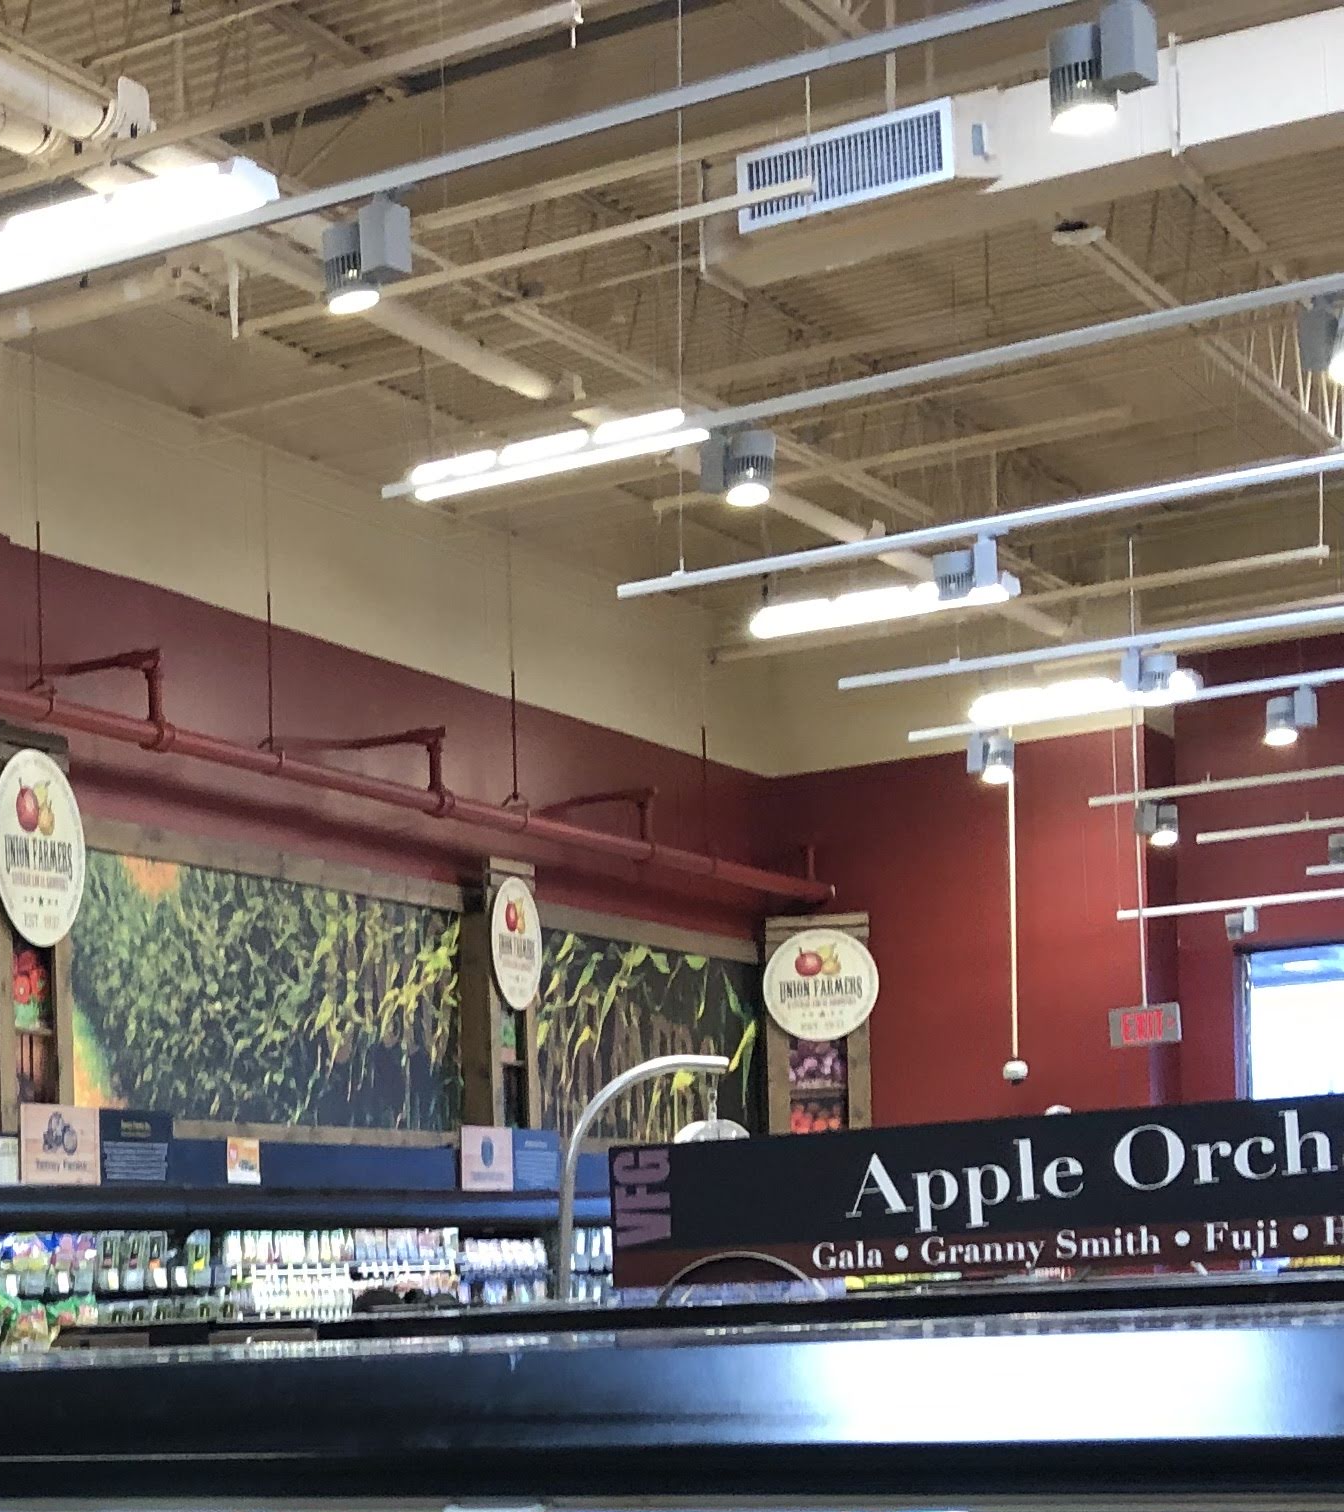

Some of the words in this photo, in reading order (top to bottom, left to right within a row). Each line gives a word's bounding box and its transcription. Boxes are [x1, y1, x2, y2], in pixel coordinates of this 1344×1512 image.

[4, 834, 30, 874] UNION
[32, 837, 73, 880] FARMERS
[779, 980, 810, 1003] UNION
[813, 976, 863, 999] FARMERS
[1121, 1008, 1164, 1042] EXIT
[845, 1137, 1085, 1233] Apple
[1111, 1108, 1344, 1191] Orch
[612, 1146, 671, 1248] VFG
[812, 1241, 884, 1272] Gala
[920, 1236, 1045, 1271] Granny
[1055, 1227, 1162, 1261] Smith
[1204, 1220, 1279, 1260] Fuji
